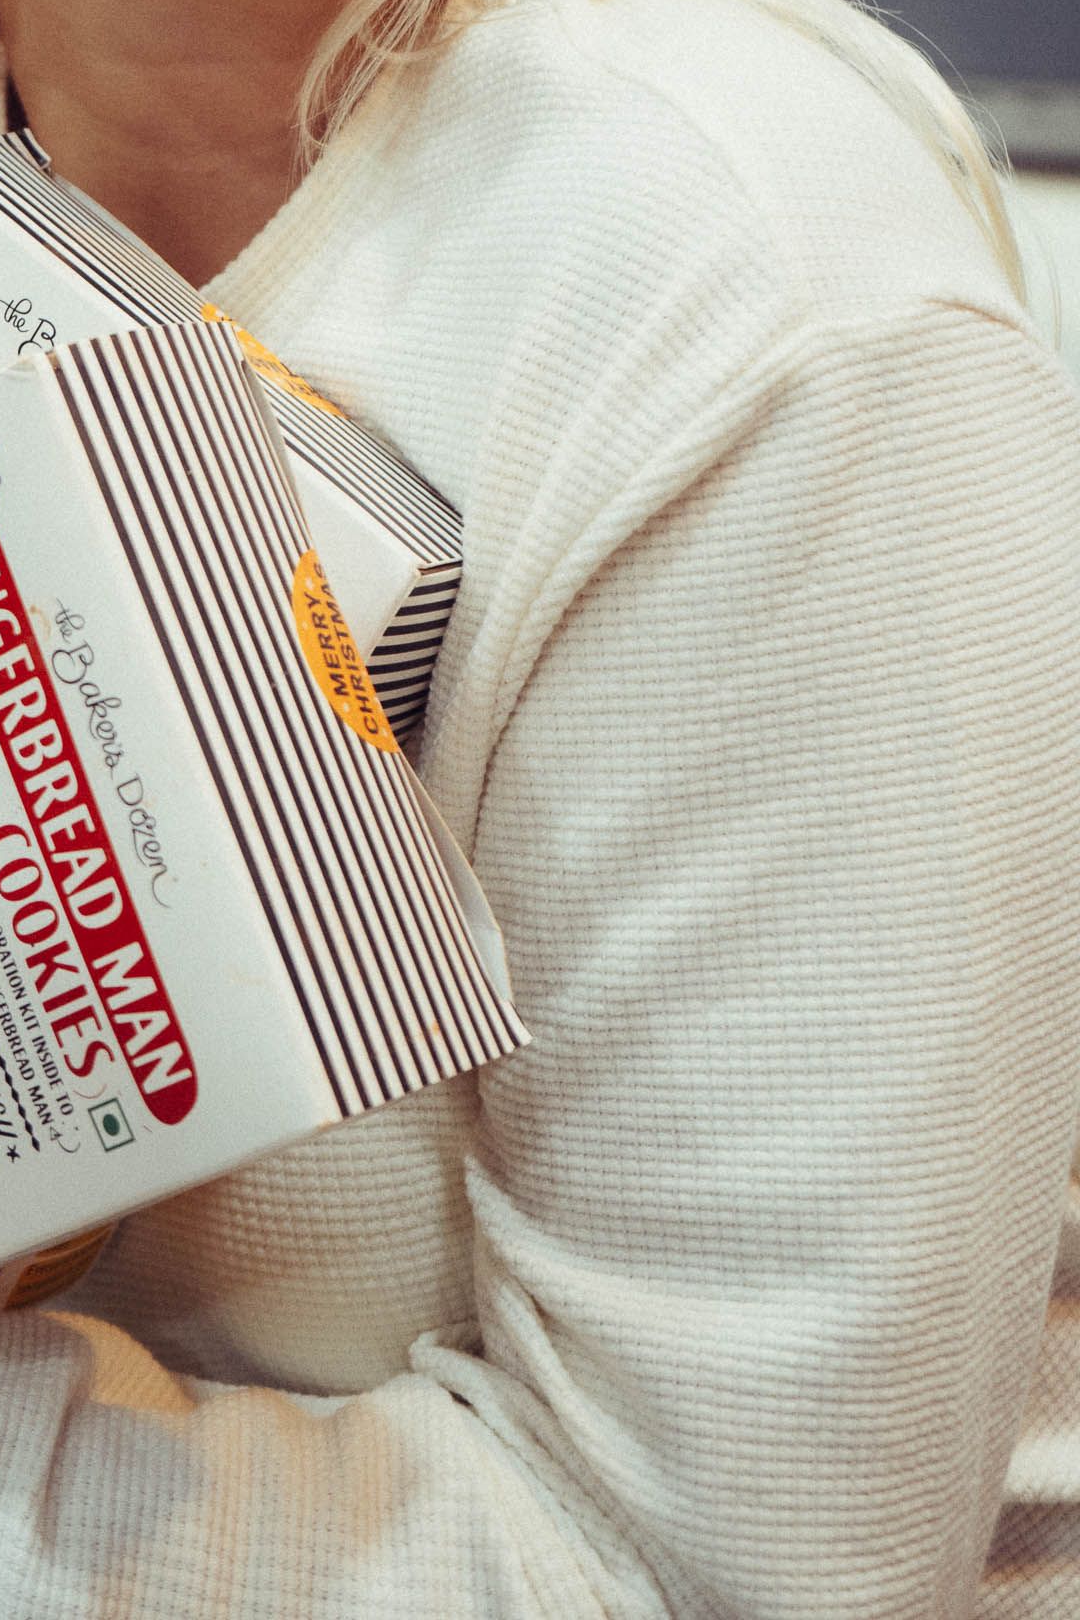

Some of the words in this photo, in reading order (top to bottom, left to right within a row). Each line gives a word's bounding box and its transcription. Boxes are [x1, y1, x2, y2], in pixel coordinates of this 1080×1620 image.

[304, 591, 350, 697] MERRY
[55, 597, 85, 643] the
[116, 773, 171, 908] Dozen
[19, 1002, 40, 1030] KIT
[31, 1035, 64, 1090] INSIDE
[56, 1091, 74, 1116] TO
[93, 941, 193, 1096] MAN
[28, 1085, 54, 1125] MAN
